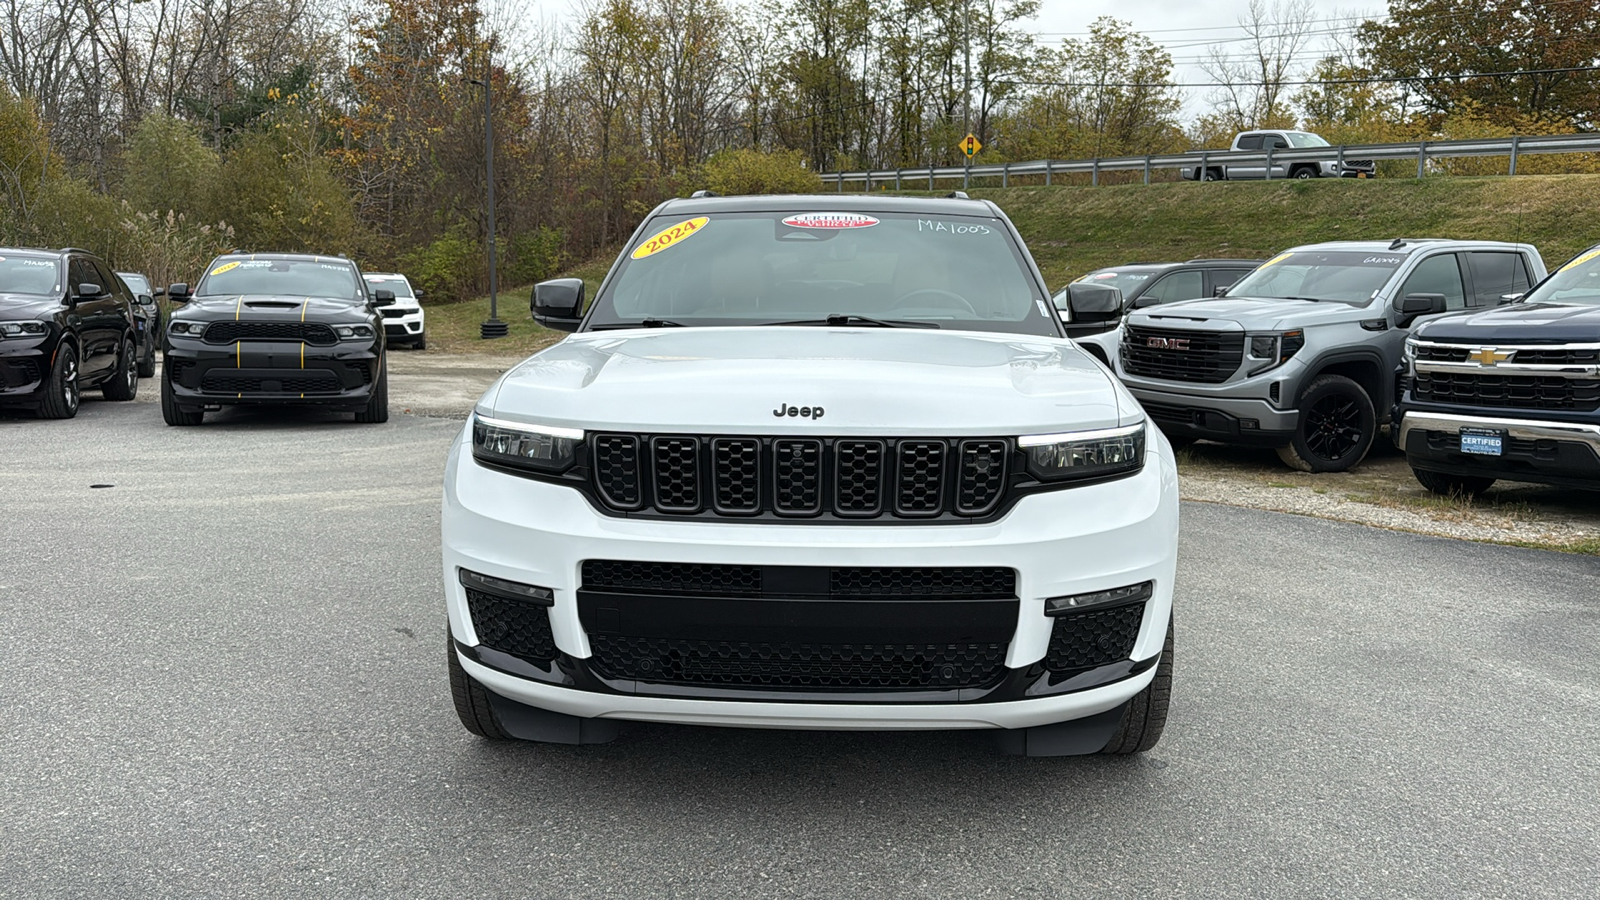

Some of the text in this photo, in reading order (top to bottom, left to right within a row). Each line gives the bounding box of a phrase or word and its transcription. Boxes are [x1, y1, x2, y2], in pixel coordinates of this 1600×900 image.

[917, 218, 990, 235] MA1003
[646, 221, 698, 253] 2024
[1147, 336, 1190, 350] GMC
[773, 403, 825, 420] Jeep
[1461, 437, 1502, 447] CERTIFIED
